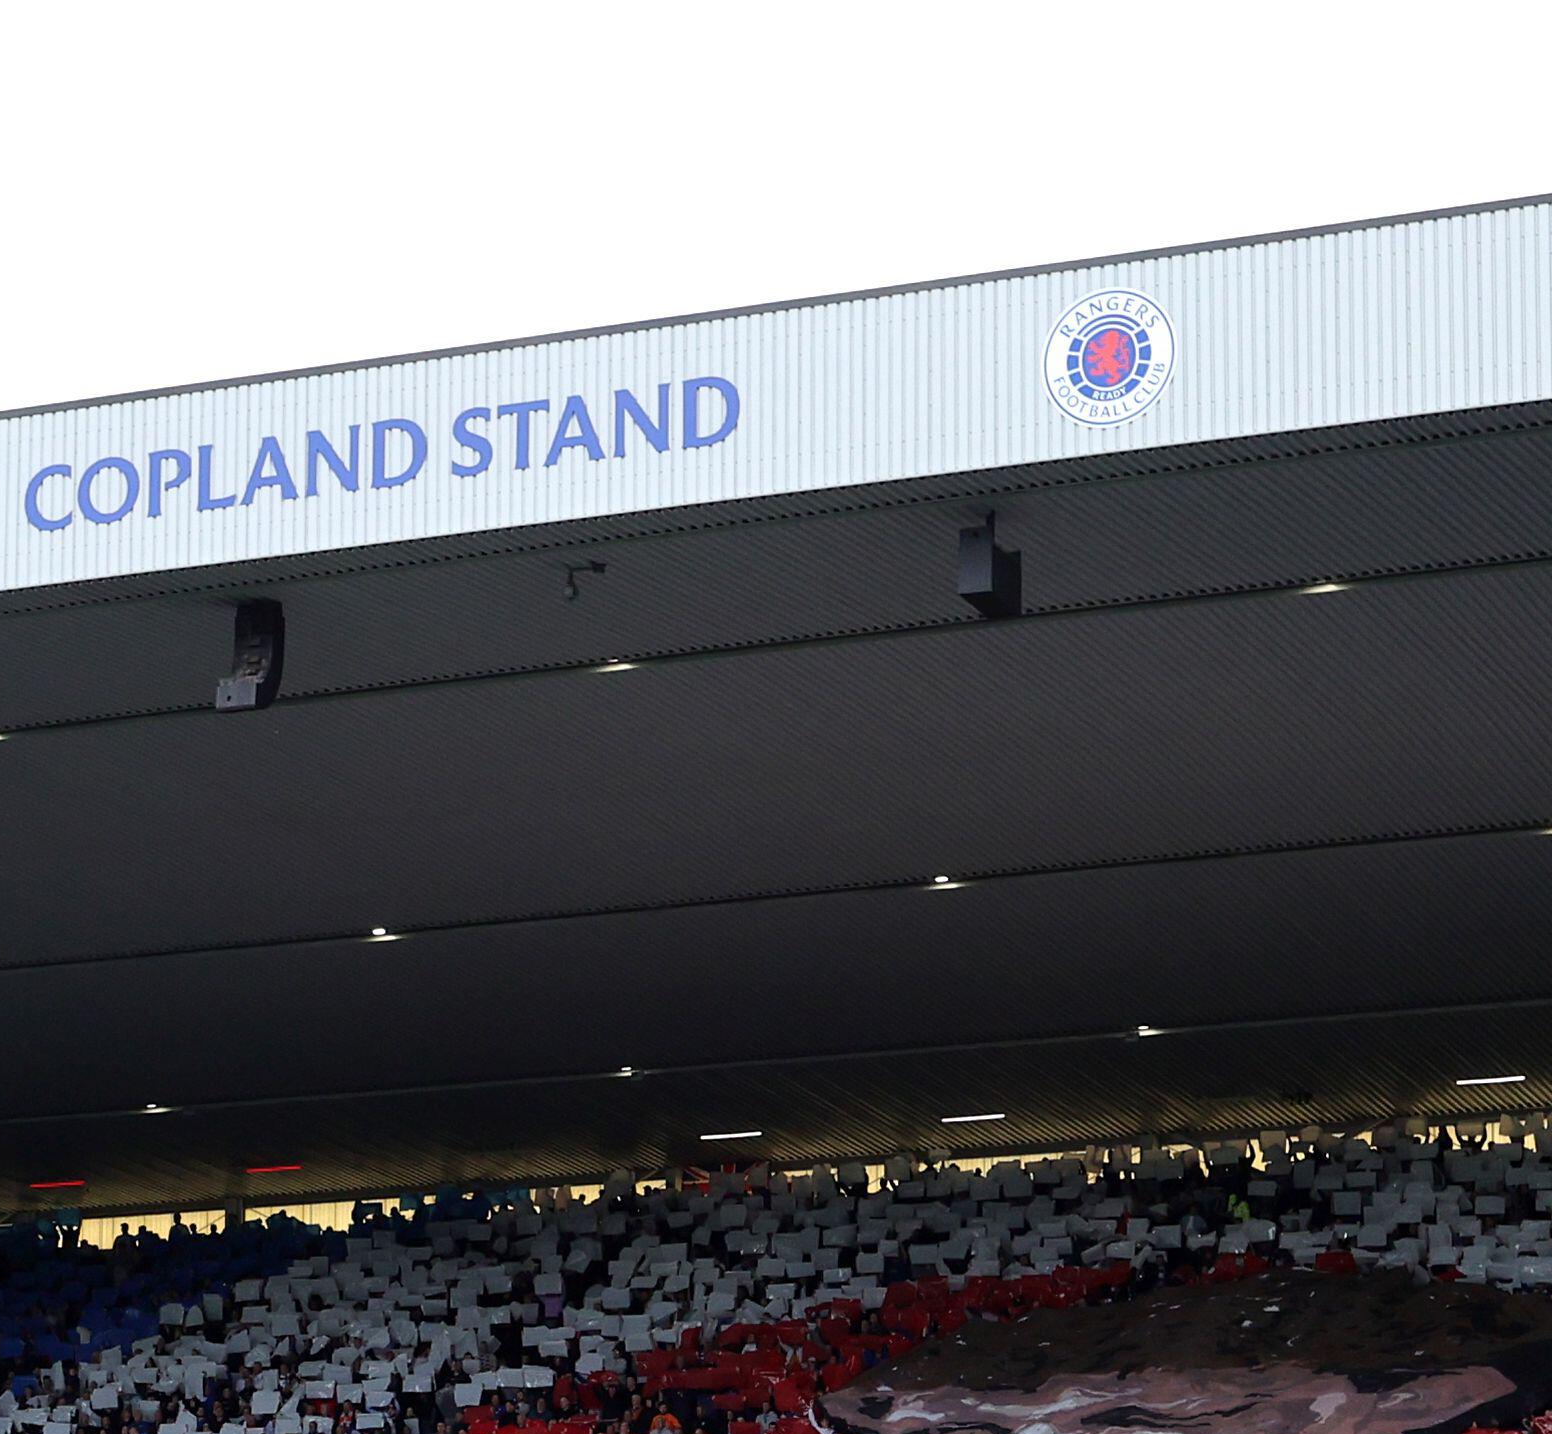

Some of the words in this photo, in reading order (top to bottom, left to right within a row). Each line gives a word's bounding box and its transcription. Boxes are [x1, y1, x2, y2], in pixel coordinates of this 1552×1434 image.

[1060, 297, 1160, 338] RANGERS
[1053, 375, 1132, 418] FOOTBALL
[1133, 362, 1165, 404] CLUB
[24, 417, 428, 532] COPLAND
[450, 376, 741, 478] STAND
